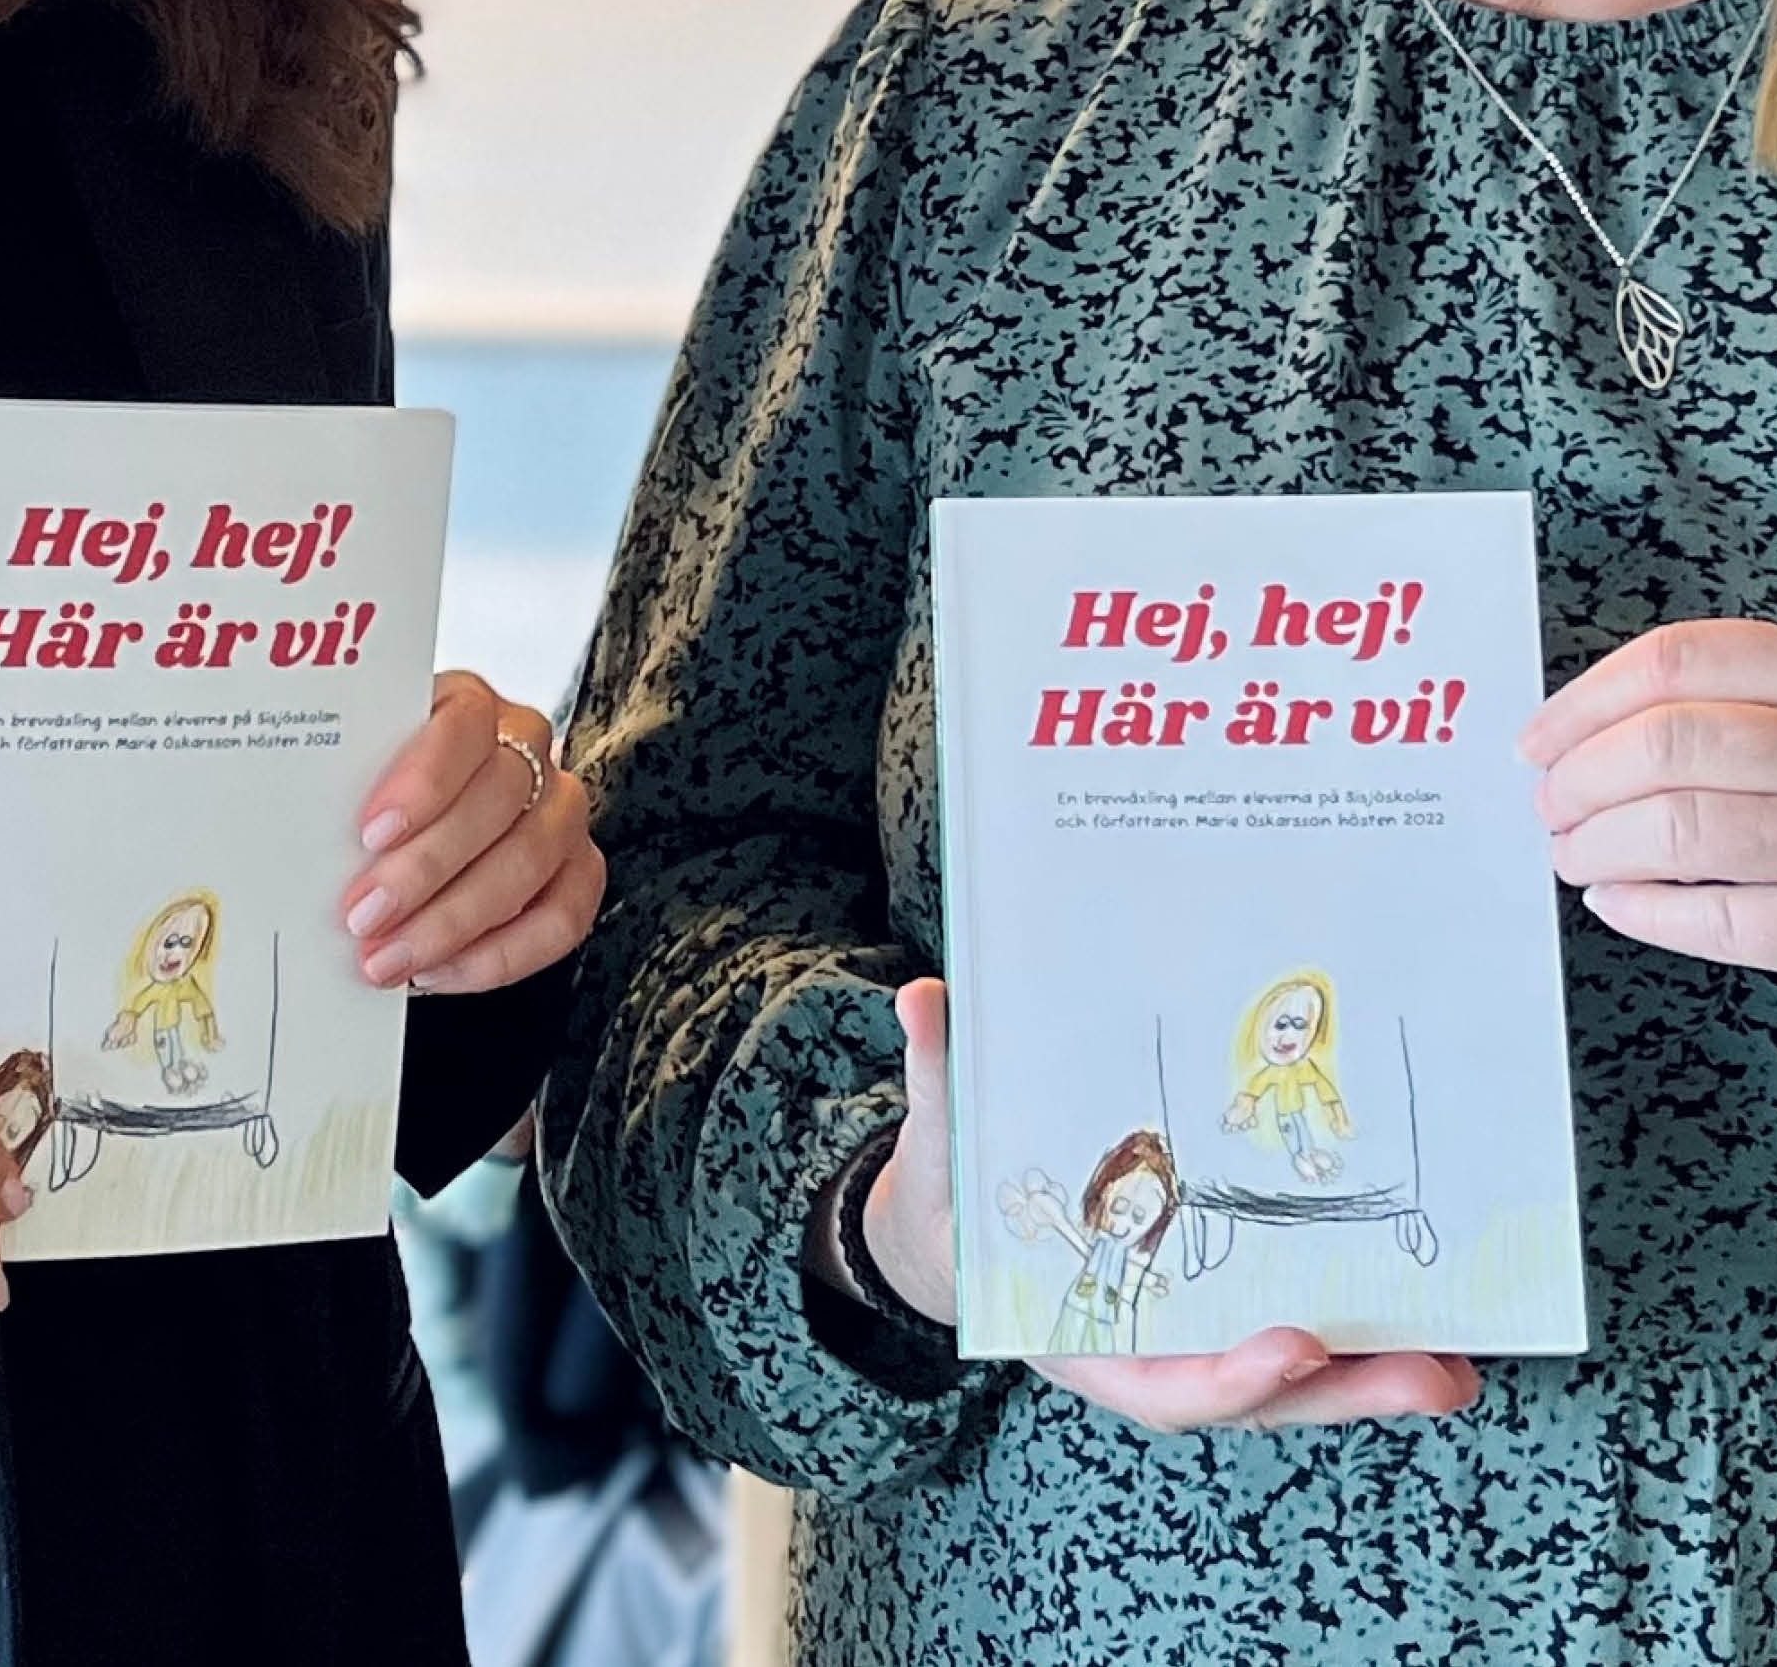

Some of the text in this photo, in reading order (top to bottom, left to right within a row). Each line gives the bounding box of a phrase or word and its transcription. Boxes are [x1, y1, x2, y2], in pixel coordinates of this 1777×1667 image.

[8, 502, 354, 584] Hej, hej!
[154, 603, 258, 668] är
[269, 601, 377, 666] vi!
[1060, 581, 1425, 663] Hej, hej!
[108, 712, 158, 727] mellan
[164, 710, 227, 727] eleverna
[232, 710, 252, 729] på
[258, 710, 340, 729] Sisjöskolan
[1029, 679, 1466, 747] Här är vi!
[16, 735, 110, 750] författaren
[115, 736, 157, 750] Marie
[163, 735, 242, 750] Oskarsson
[247, 734, 299, 748] hösten
[1055, 812, 1445, 828] och författaren Marie Oskarsson hösten 2022
[1056, 789, 1442, 809] En brevväxling mellan eleverna på Sisjöskolan
